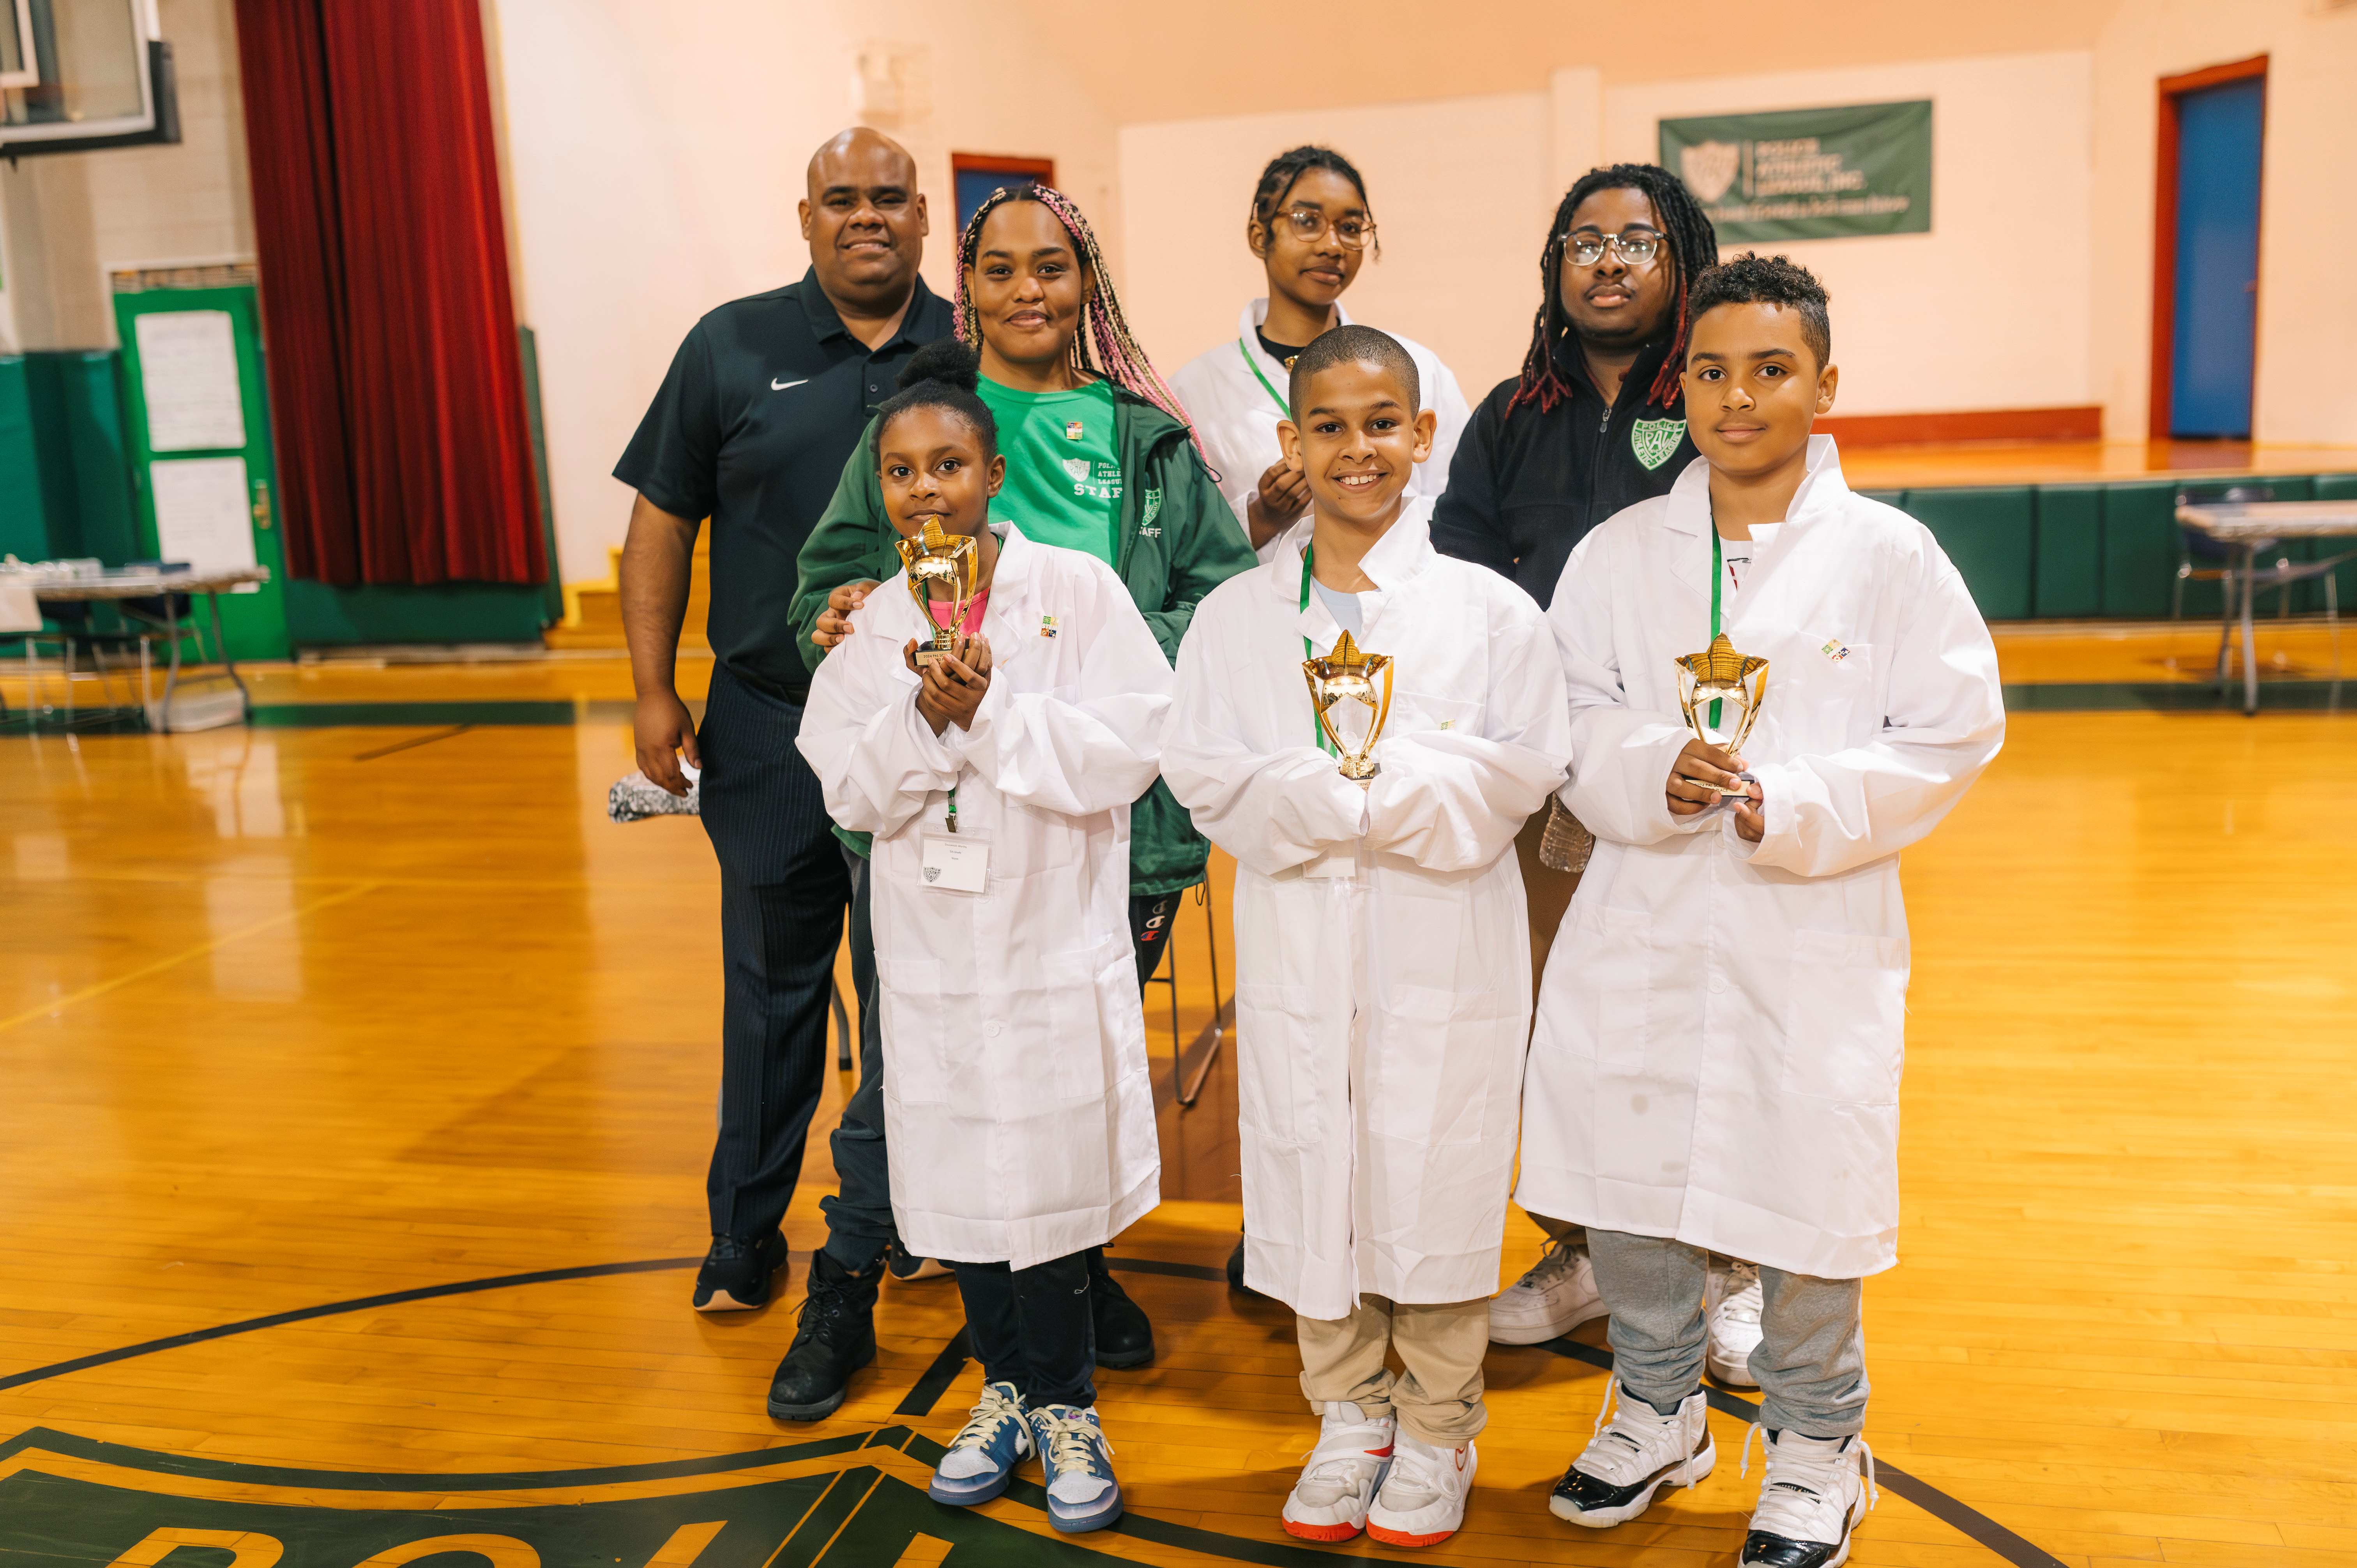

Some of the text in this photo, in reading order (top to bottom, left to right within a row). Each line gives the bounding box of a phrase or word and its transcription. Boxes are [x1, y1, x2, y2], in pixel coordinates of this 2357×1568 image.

[1645, 430, 1670, 450] PAL
[1074, 483, 1123, 498] STAF
[1139, 526, 1162, 538] AFF
